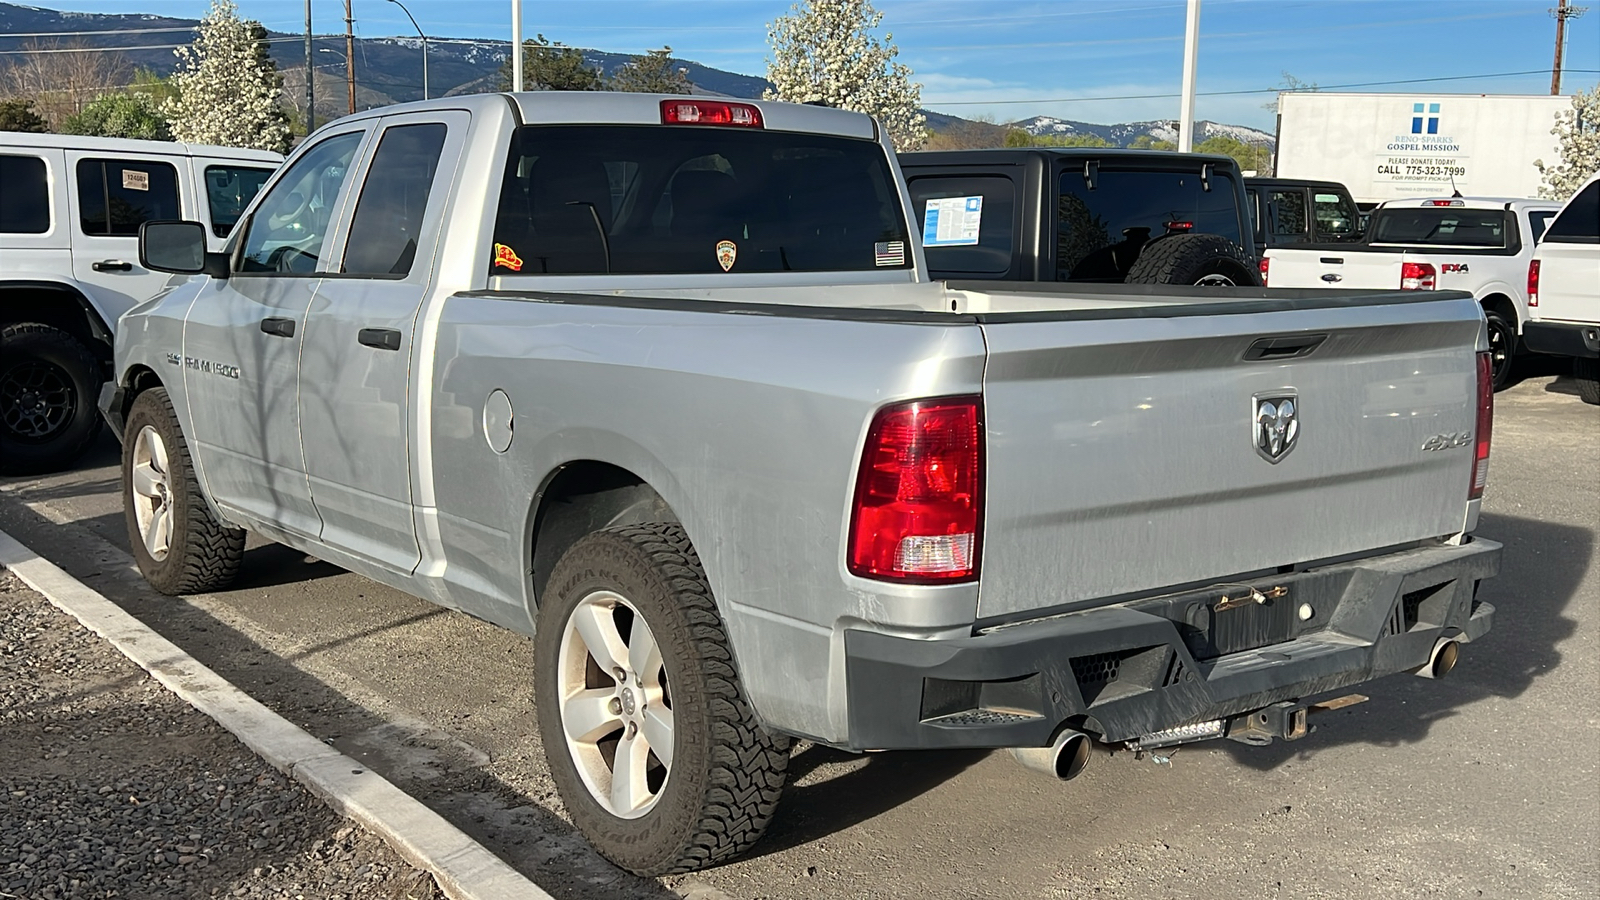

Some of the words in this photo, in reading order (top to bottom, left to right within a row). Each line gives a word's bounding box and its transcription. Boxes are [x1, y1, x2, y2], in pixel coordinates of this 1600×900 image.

[1395, 135, 1453, 144] RENO-SPARKS
[1422, 144, 1460, 152] MISSION
[1388, 157, 1409, 165] PLEASE
[1377, 165, 1401, 174] CALL
[1406, 165, 1465, 176] 775-323-7999
[1441, 263, 1469, 274] FX4
[185, 357, 211, 372] RAM
